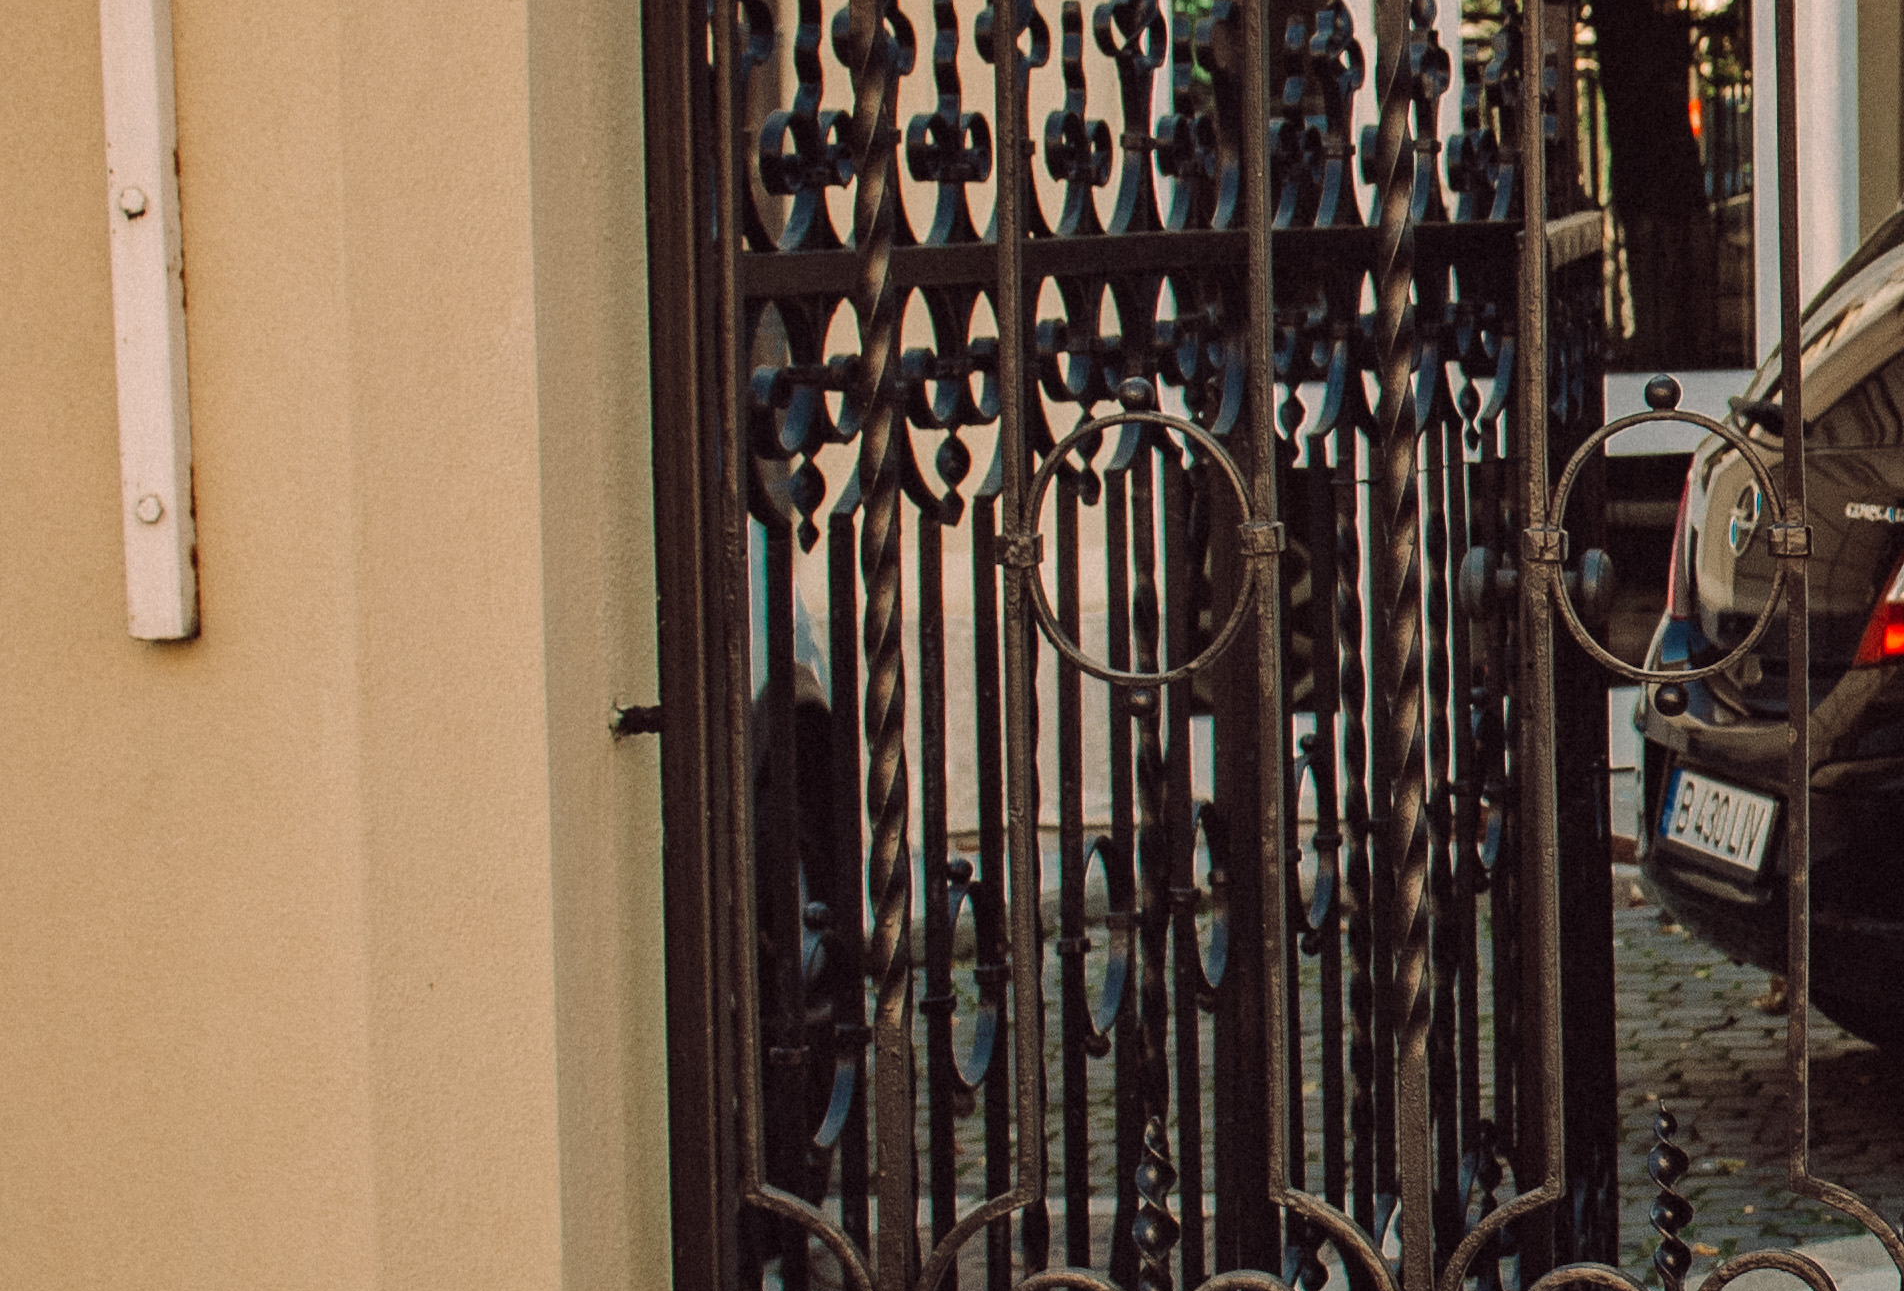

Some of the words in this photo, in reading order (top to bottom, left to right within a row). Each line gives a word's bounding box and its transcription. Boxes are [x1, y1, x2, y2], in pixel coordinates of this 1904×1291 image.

[1675, 780, 1695, 834] B
[1694, 788, 1730, 848] 430
[1727, 797, 1767, 861] LIV
